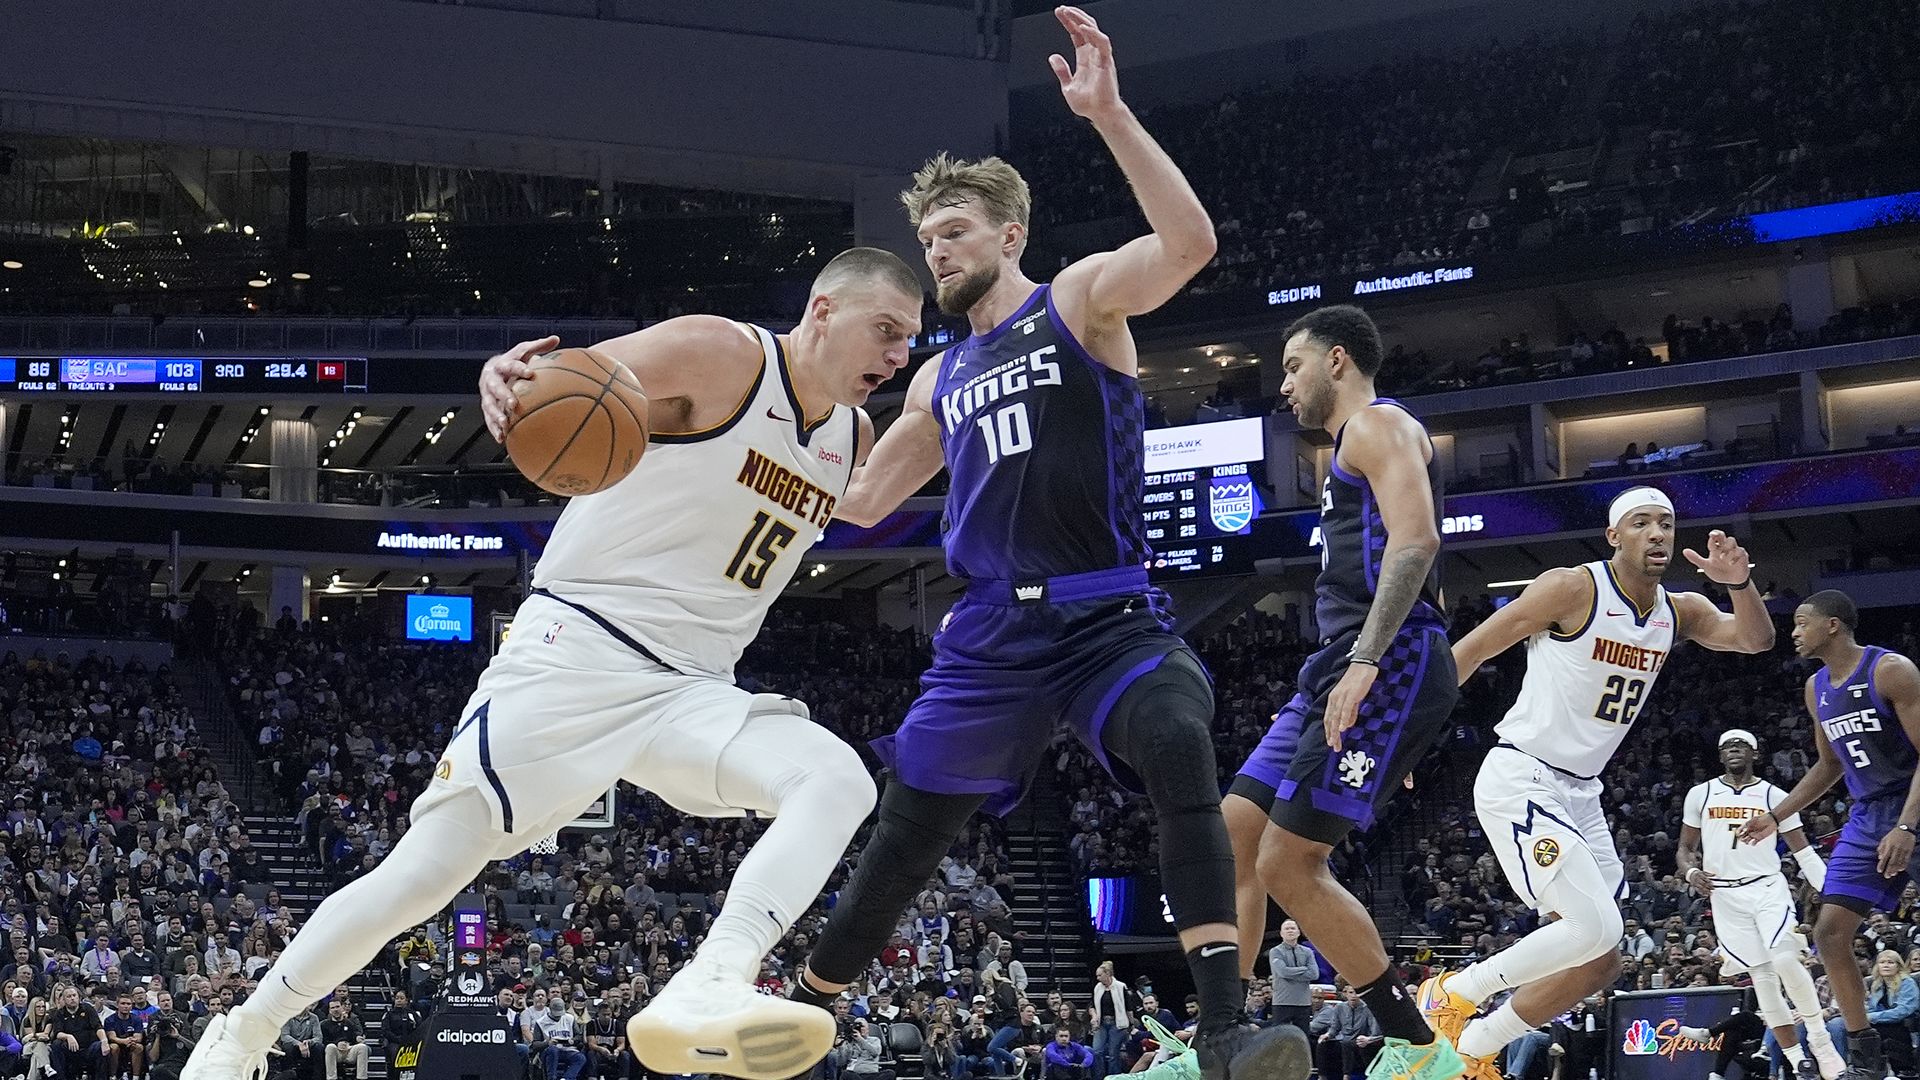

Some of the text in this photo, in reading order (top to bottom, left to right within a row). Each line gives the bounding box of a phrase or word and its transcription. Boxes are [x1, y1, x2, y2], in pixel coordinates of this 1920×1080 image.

[1354, 266, 1473, 294] Authentic Fans
[1268, 285, 1320, 304] 8:50 PM
[28, 362, 50, 377] 86
[93, 362, 128, 376] SAC
[165, 363, 195, 377] 103
[215, 363, 307, 378] 3RD :29.4
[977, 402, 1033, 464] 10
[1145, 439, 1202, 452] REDHAWK
[1162, 471, 1196, 484] STATS
[1213, 464, 1248, 477] KINGS
[737, 448, 836, 529] NUGGETS
[1153, 510, 1170, 521] PTS
[1179, 507, 1195, 519] 35
[1180, 525, 1196, 537] 25
[1441, 514, 1484, 534] ans
[377, 532, 503, 550] Authentic Fans
[724, 510, 798, 589] 15
[414, 615, 461, 635] Corona
[1595, 675, 1646, 725] 22
[1846, 739, 1871, 768] 5
[437, 1029, 491, 1045] dialpad
